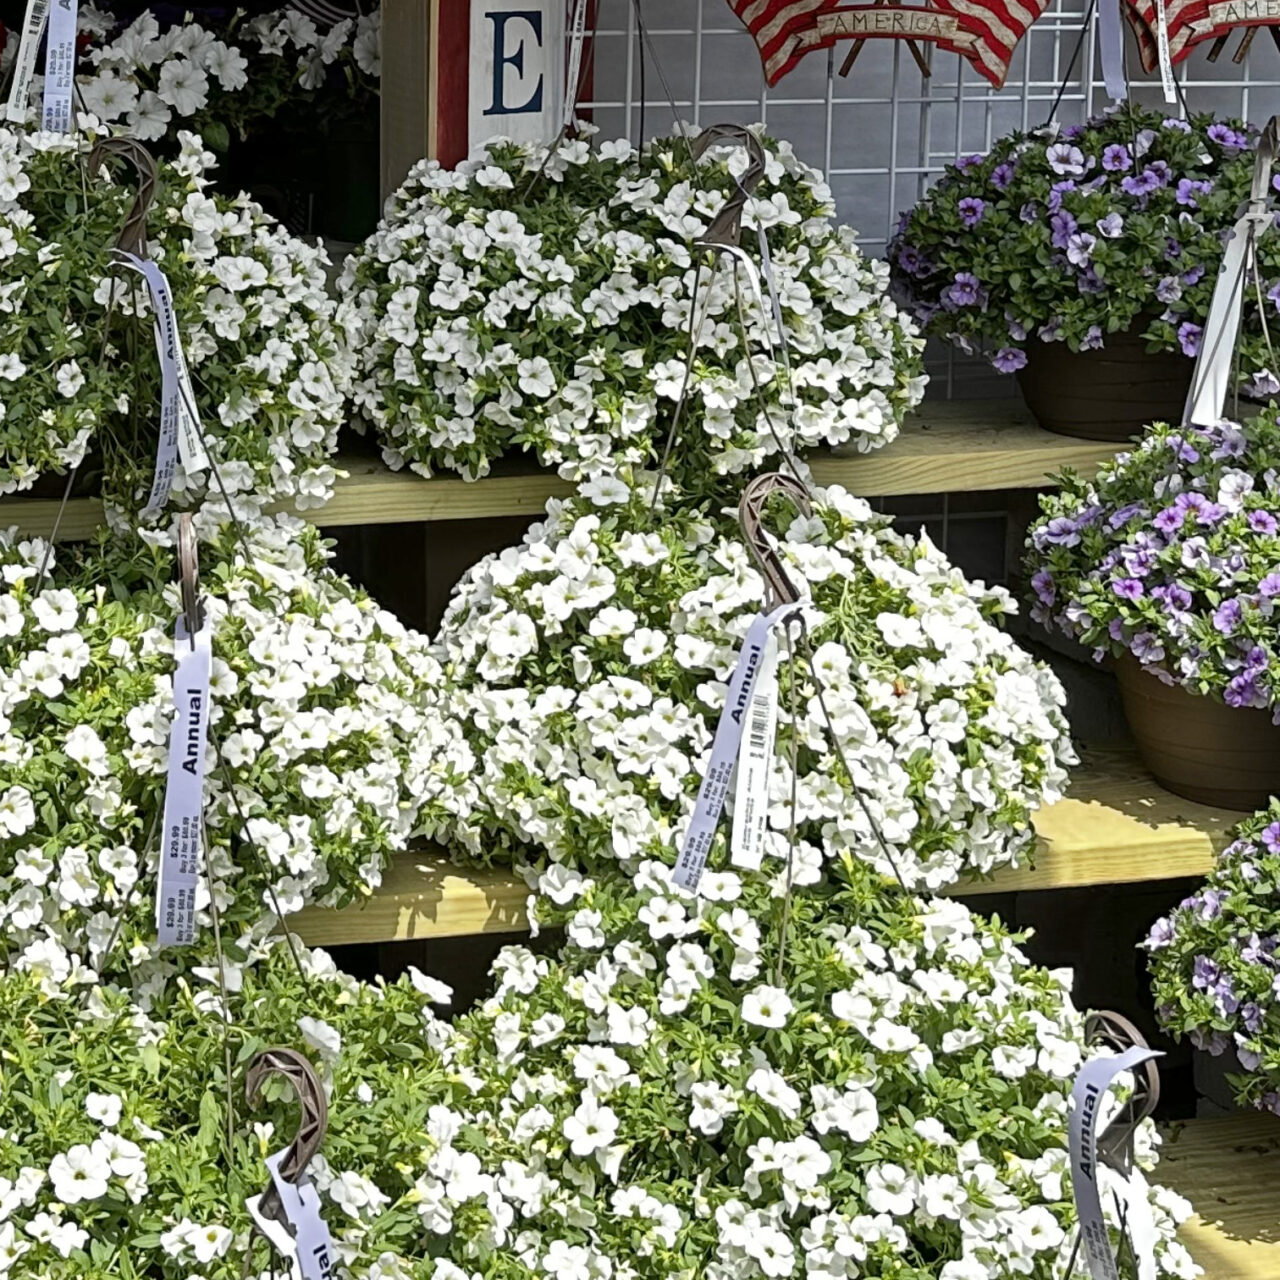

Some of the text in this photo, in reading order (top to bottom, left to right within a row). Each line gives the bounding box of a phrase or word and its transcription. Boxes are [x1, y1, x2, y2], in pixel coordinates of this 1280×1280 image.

[833, 12, 942, 35] AMERICA
[158, 289, 175, 360] Annual
[730, 644, 761, 726] Annual
[182, 688, 203, 776] Annual
[1079, 1083, 1100, 1181] Annual
